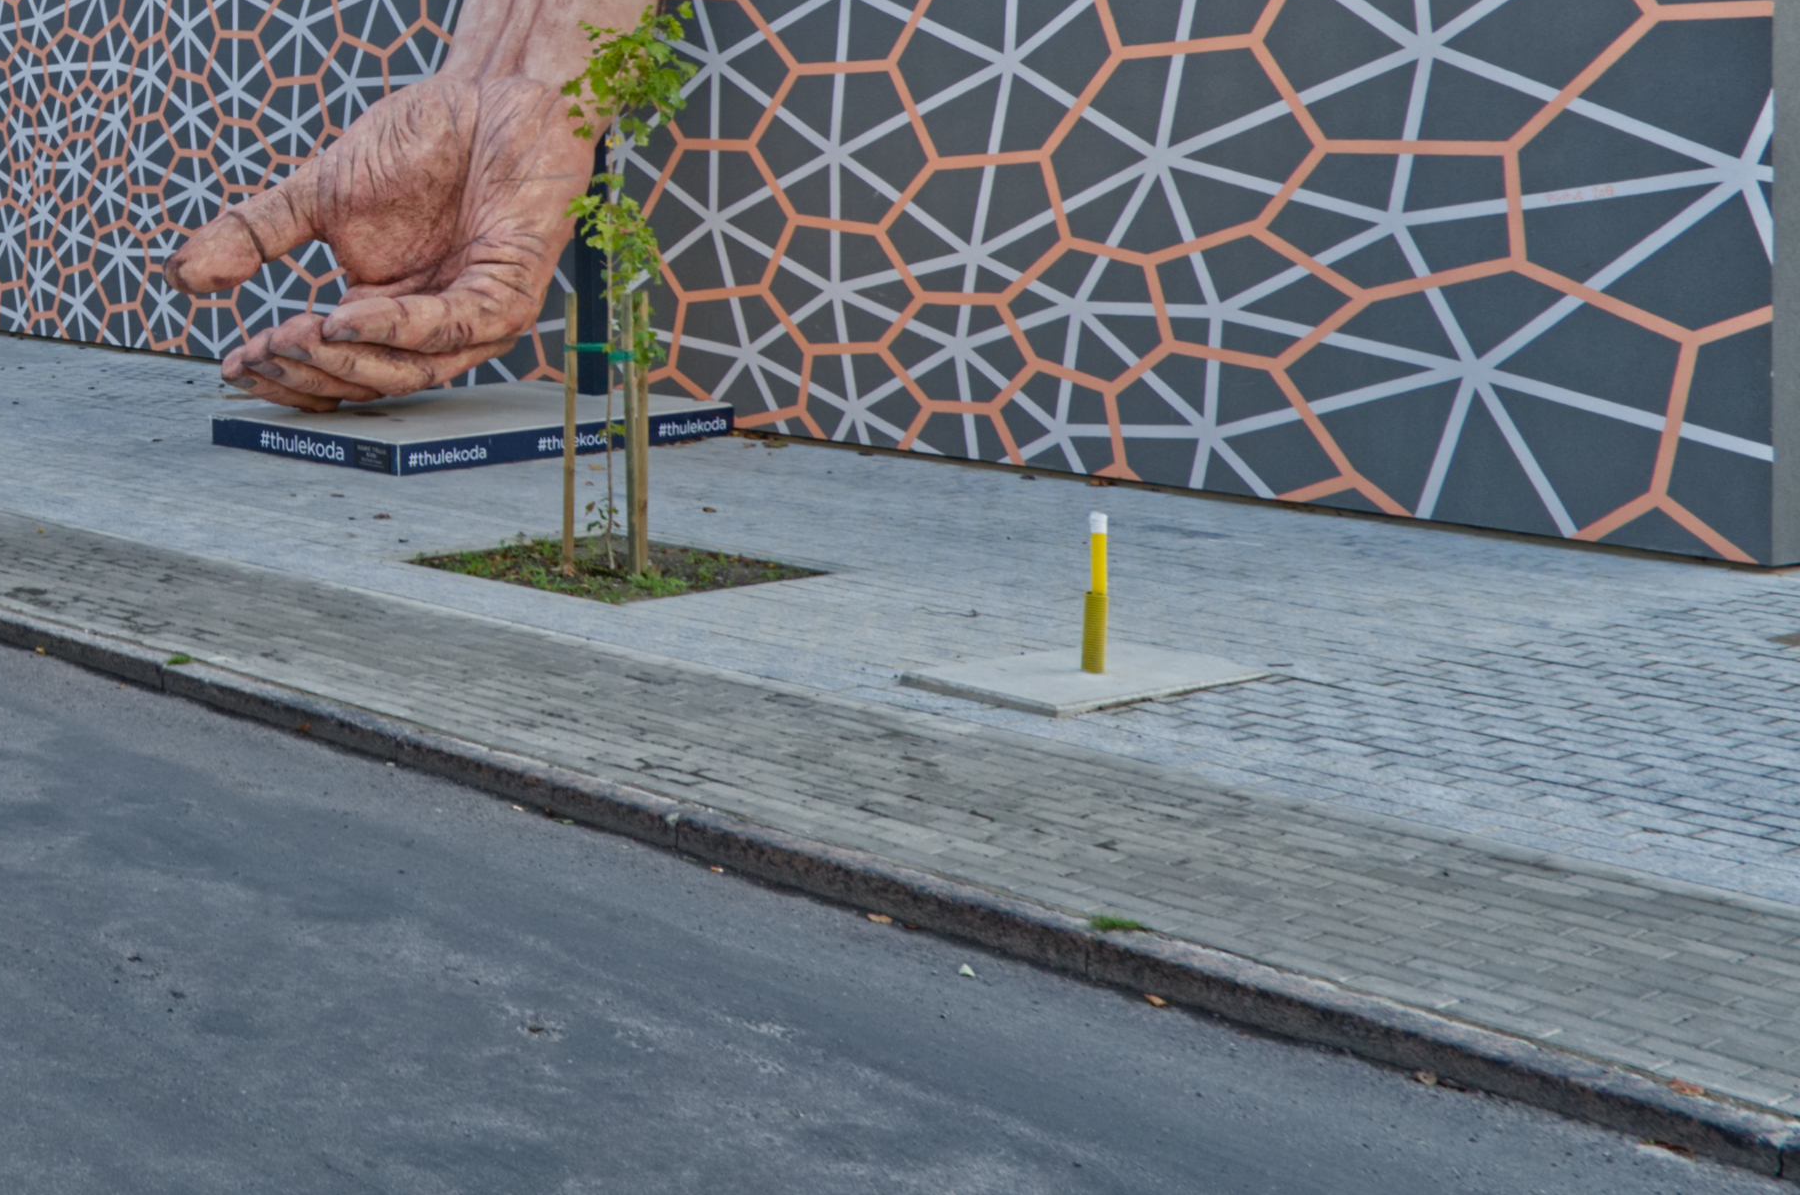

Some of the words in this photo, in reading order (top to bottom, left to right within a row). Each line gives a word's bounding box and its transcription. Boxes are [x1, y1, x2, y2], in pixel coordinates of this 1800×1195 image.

[658, 416, 727, 437] #thulekoda
[260, 430, 345, 461] #thulekoda
[408, 444, 487, 467] #thulekoda
